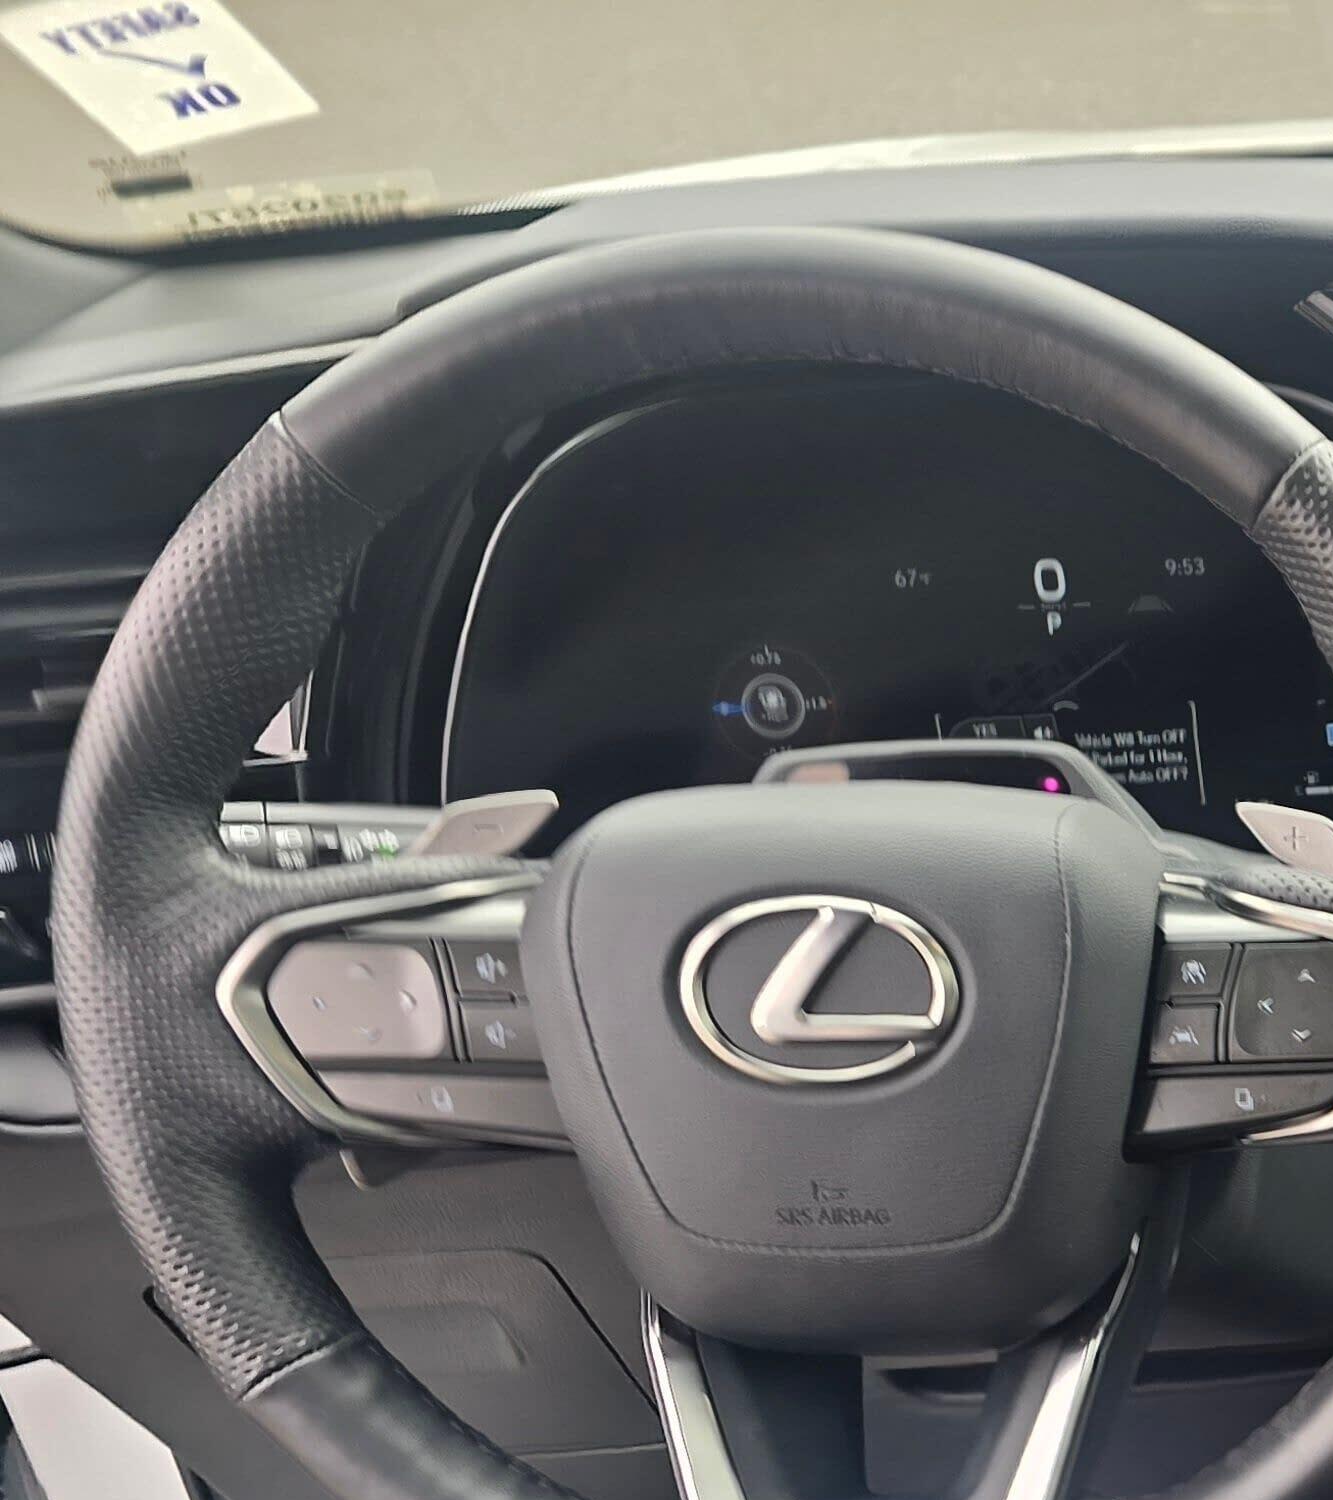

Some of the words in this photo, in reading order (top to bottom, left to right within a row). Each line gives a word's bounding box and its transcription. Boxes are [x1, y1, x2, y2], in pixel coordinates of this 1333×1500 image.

[1164, 556, 1206, 577] 9:53
[1033, 557, 1066, 604] 0
[1161, 728, 1188, 744] OFF
[776, 1207, 814, 1226] SRS
[817, 1207, 892, 1226] AIRBAG
